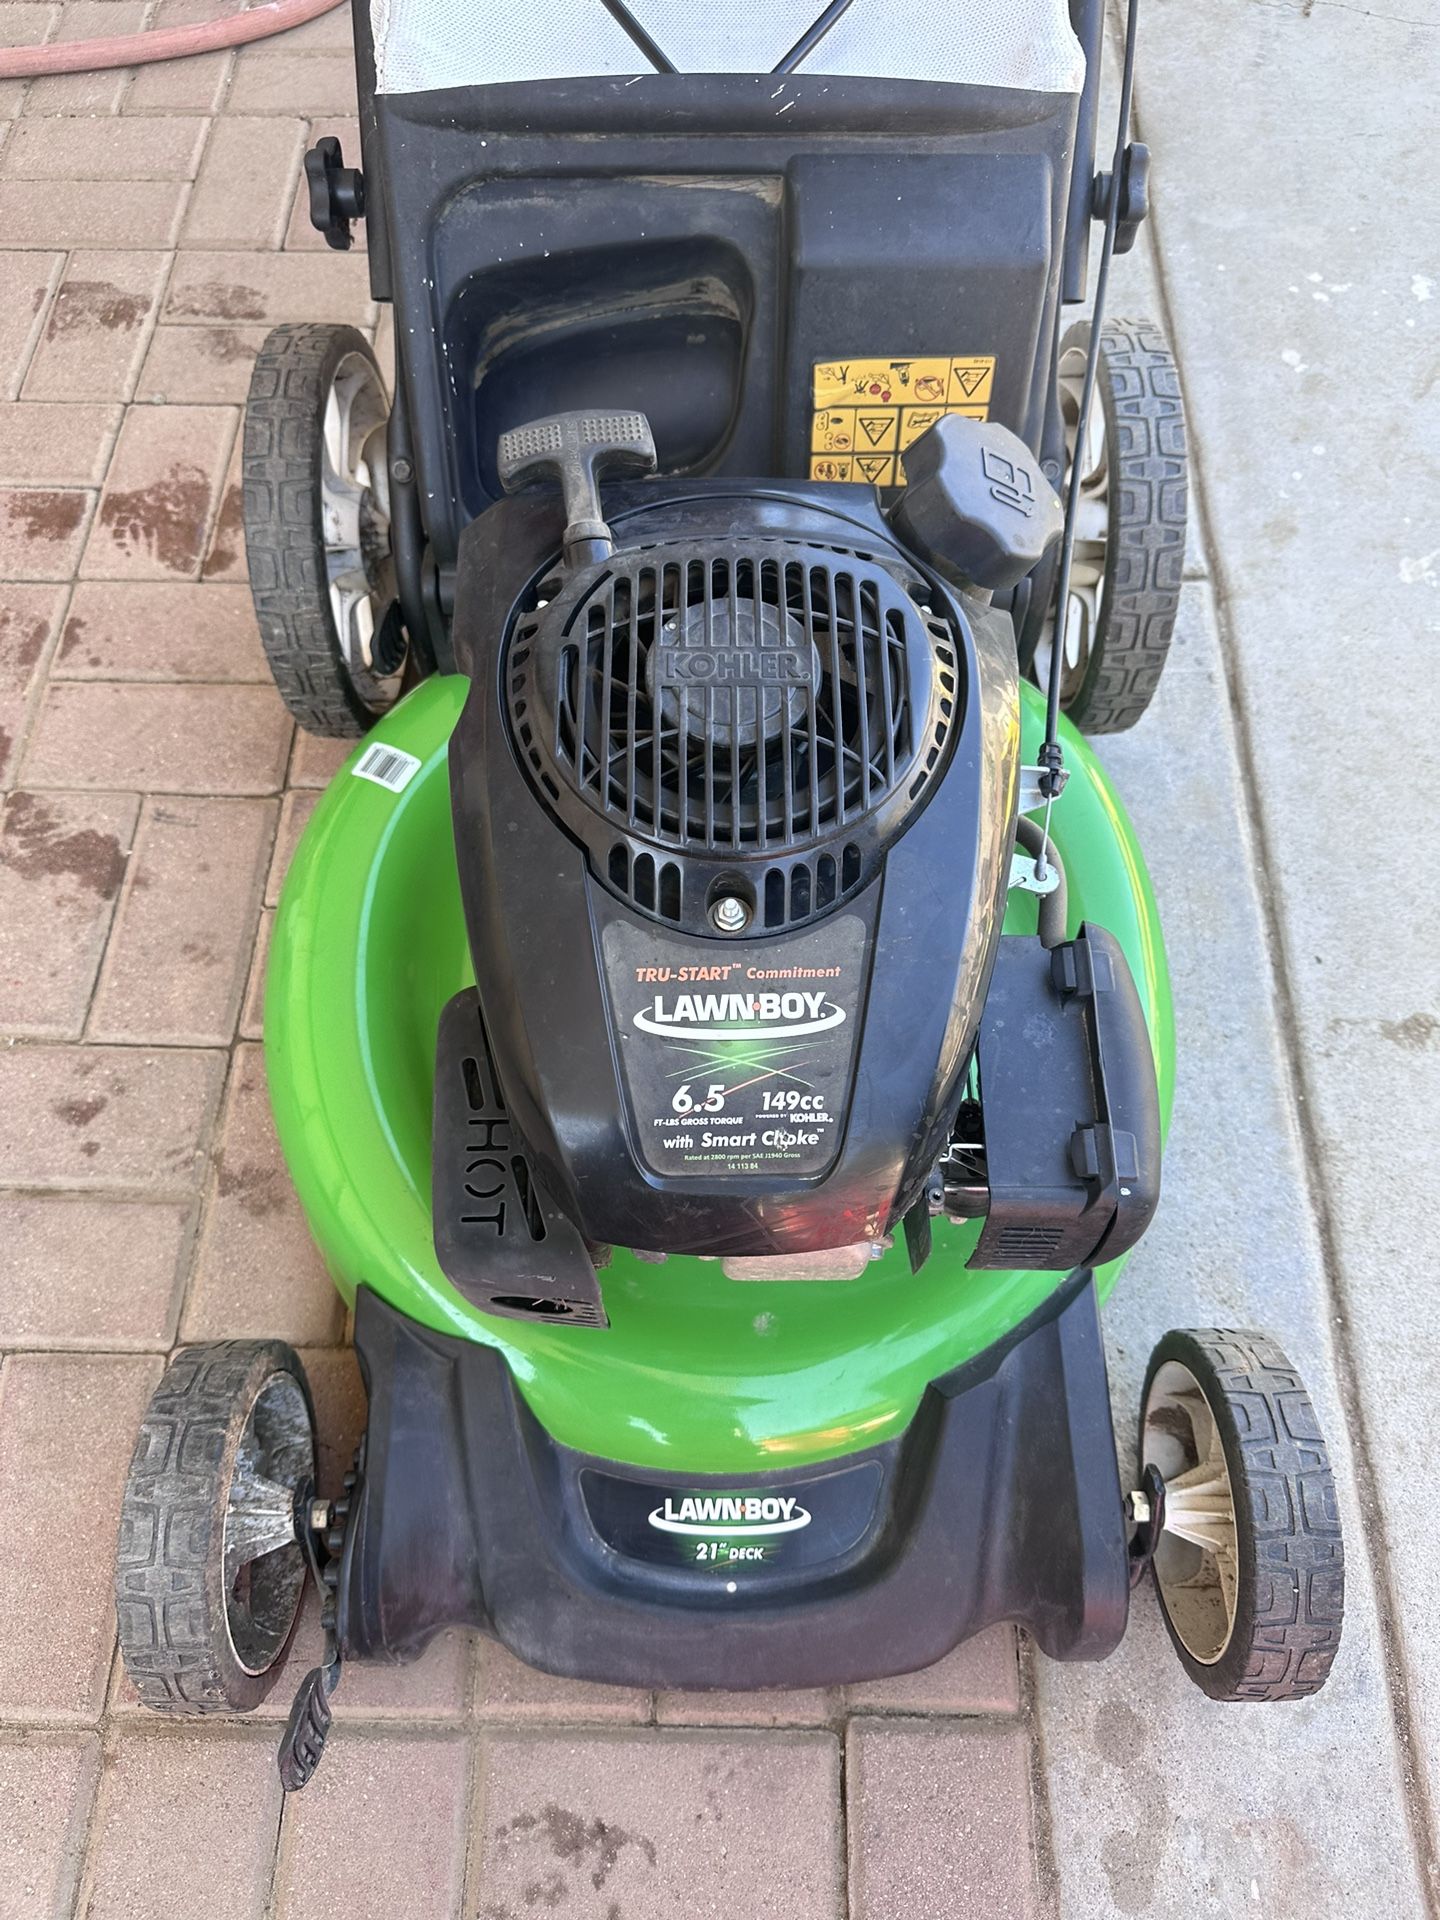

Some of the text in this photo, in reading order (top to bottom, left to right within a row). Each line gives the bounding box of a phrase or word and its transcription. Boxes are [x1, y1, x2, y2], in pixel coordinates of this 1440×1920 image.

[747, 966, 841, 980] Commitment
[672, 1084, 725, 1113] 6.5
[762, 1090, 824, 1110] 149cc
[653, 1117, 744, 1126] FT-LBS GROSS TORQUE
[663, 1134, 694, 1148] with
[701, 1132, 757, 1147] Smart
[461, 1118, 509, 1237] HOT
[729, 1547, 764, 1560] DECK
